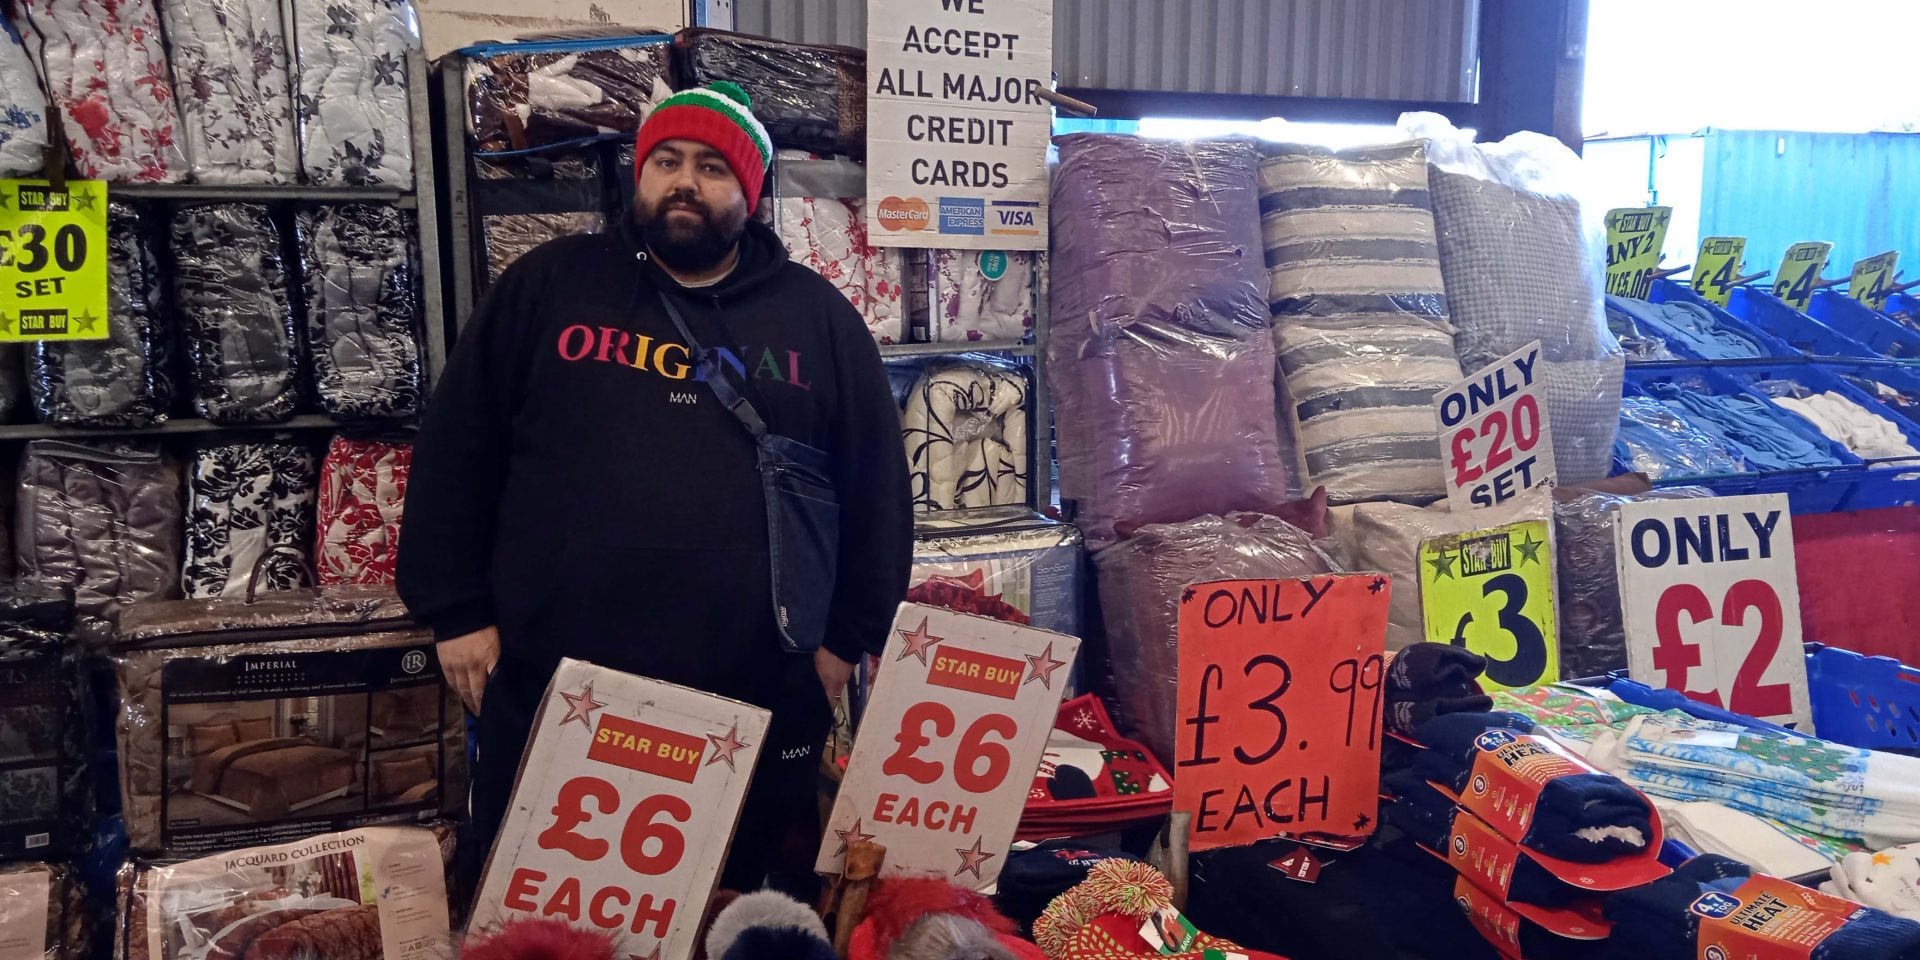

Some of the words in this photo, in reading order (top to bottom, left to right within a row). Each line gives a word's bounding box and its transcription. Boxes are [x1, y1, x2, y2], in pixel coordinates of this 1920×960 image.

[902, 25, 1019, 60] ACCEPT
[876, 67, 933, 98] ALL
[943, 72, 1042, 105] MAJOR
[908, 114, 1013, 146] CREDIT
[911, 158, 1009, 188] CARDS
[21, 191, 45, 206] STAR
[49, 192, 68, 206] BUY
[878, 208, 929, 220] MasterCard
[940, 207, 981, 216] AMERICAN
[948, 217, 984, 227] EXPRESS
[997, 210, 1034, 226] VISA
[1606, 234, 1645, 267] ANY
[1641, 231, 1655, 254] 2
[15, 277, 66, 298] SET
[1695, 256, 1736, 297] £4
[22, 315, 45, 329] STAR
[49, 314, 66, 329] BUY
[669, 391, 698, 405] MAN
[1441, 349, 1538, 427] ONLY
[1451, 394, 1540, 488] £20
[1470, 455, 1536, 507] SET
[1491, 538, 1509, 569] BUY
[1631, 511, 1781, 568] ONLY
[1204, 579, 1334, 628] ONLY
[1652, 579, 1793, 718] £2
[935, 656, 980, 678] STAR
[984, 667, 1020, 685] BUY
[1178, 654, 1384, 767] £3.99
[596, 728, 652, 754] STAR
[656, 743, 700, 765] BUY
[782, 745, 810, 760] MAN
[882, 701, 1018, 793] £6
[1503, 747, 1550, 767] HEAT
[873, 793, 977, 834] EACH
[1196, 775, 1330, 832] EACH
[538, 776, 692, 875] £6
[225, 852, 288, 871] JACQUARD
[291, 835, 365, 860] COLLECTION
[504, 867, 676, 939] EACH
[1698, 893, 1725, 914] 4.7
[1714, 902, 1733, 915] TOG
[1730, 891, 1772, 925] ULTIMATE
[1742, 898, 1788, 932] HEAT
